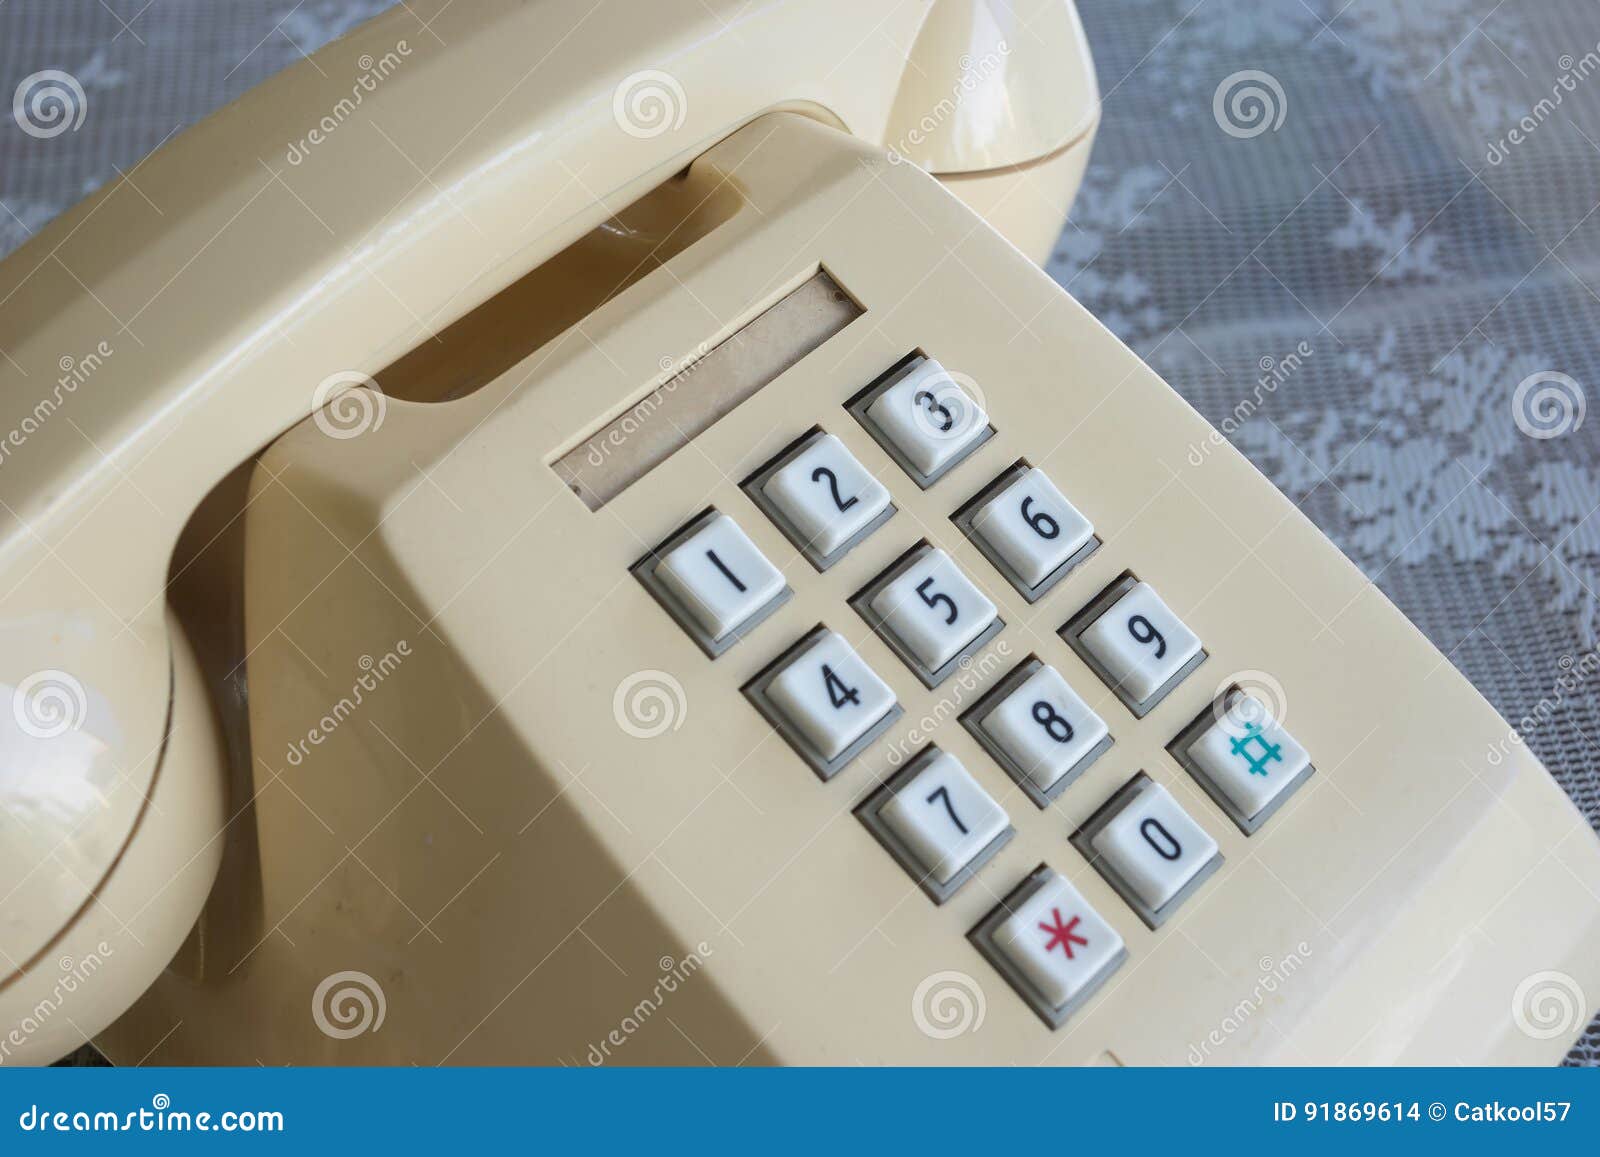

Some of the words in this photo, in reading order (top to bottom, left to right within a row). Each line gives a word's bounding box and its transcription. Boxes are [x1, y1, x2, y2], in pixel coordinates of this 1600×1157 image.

[914, 391, 953, 432] 3
[811, 466, 859, 513] 2
[1020, 495, 1061, 540] 6
[706, 549, 747, 593] 1
[915, 577, 959, 626] 5
[1127, 614, 1167, 660] 9
[821, 664, 861, 710] 4
[1031, 700, 1075, 744] 8
[1229, 722, 1283, 778] #
[926, 786, 969, 835] 7
[1139, 818, 1182, 861] 0
